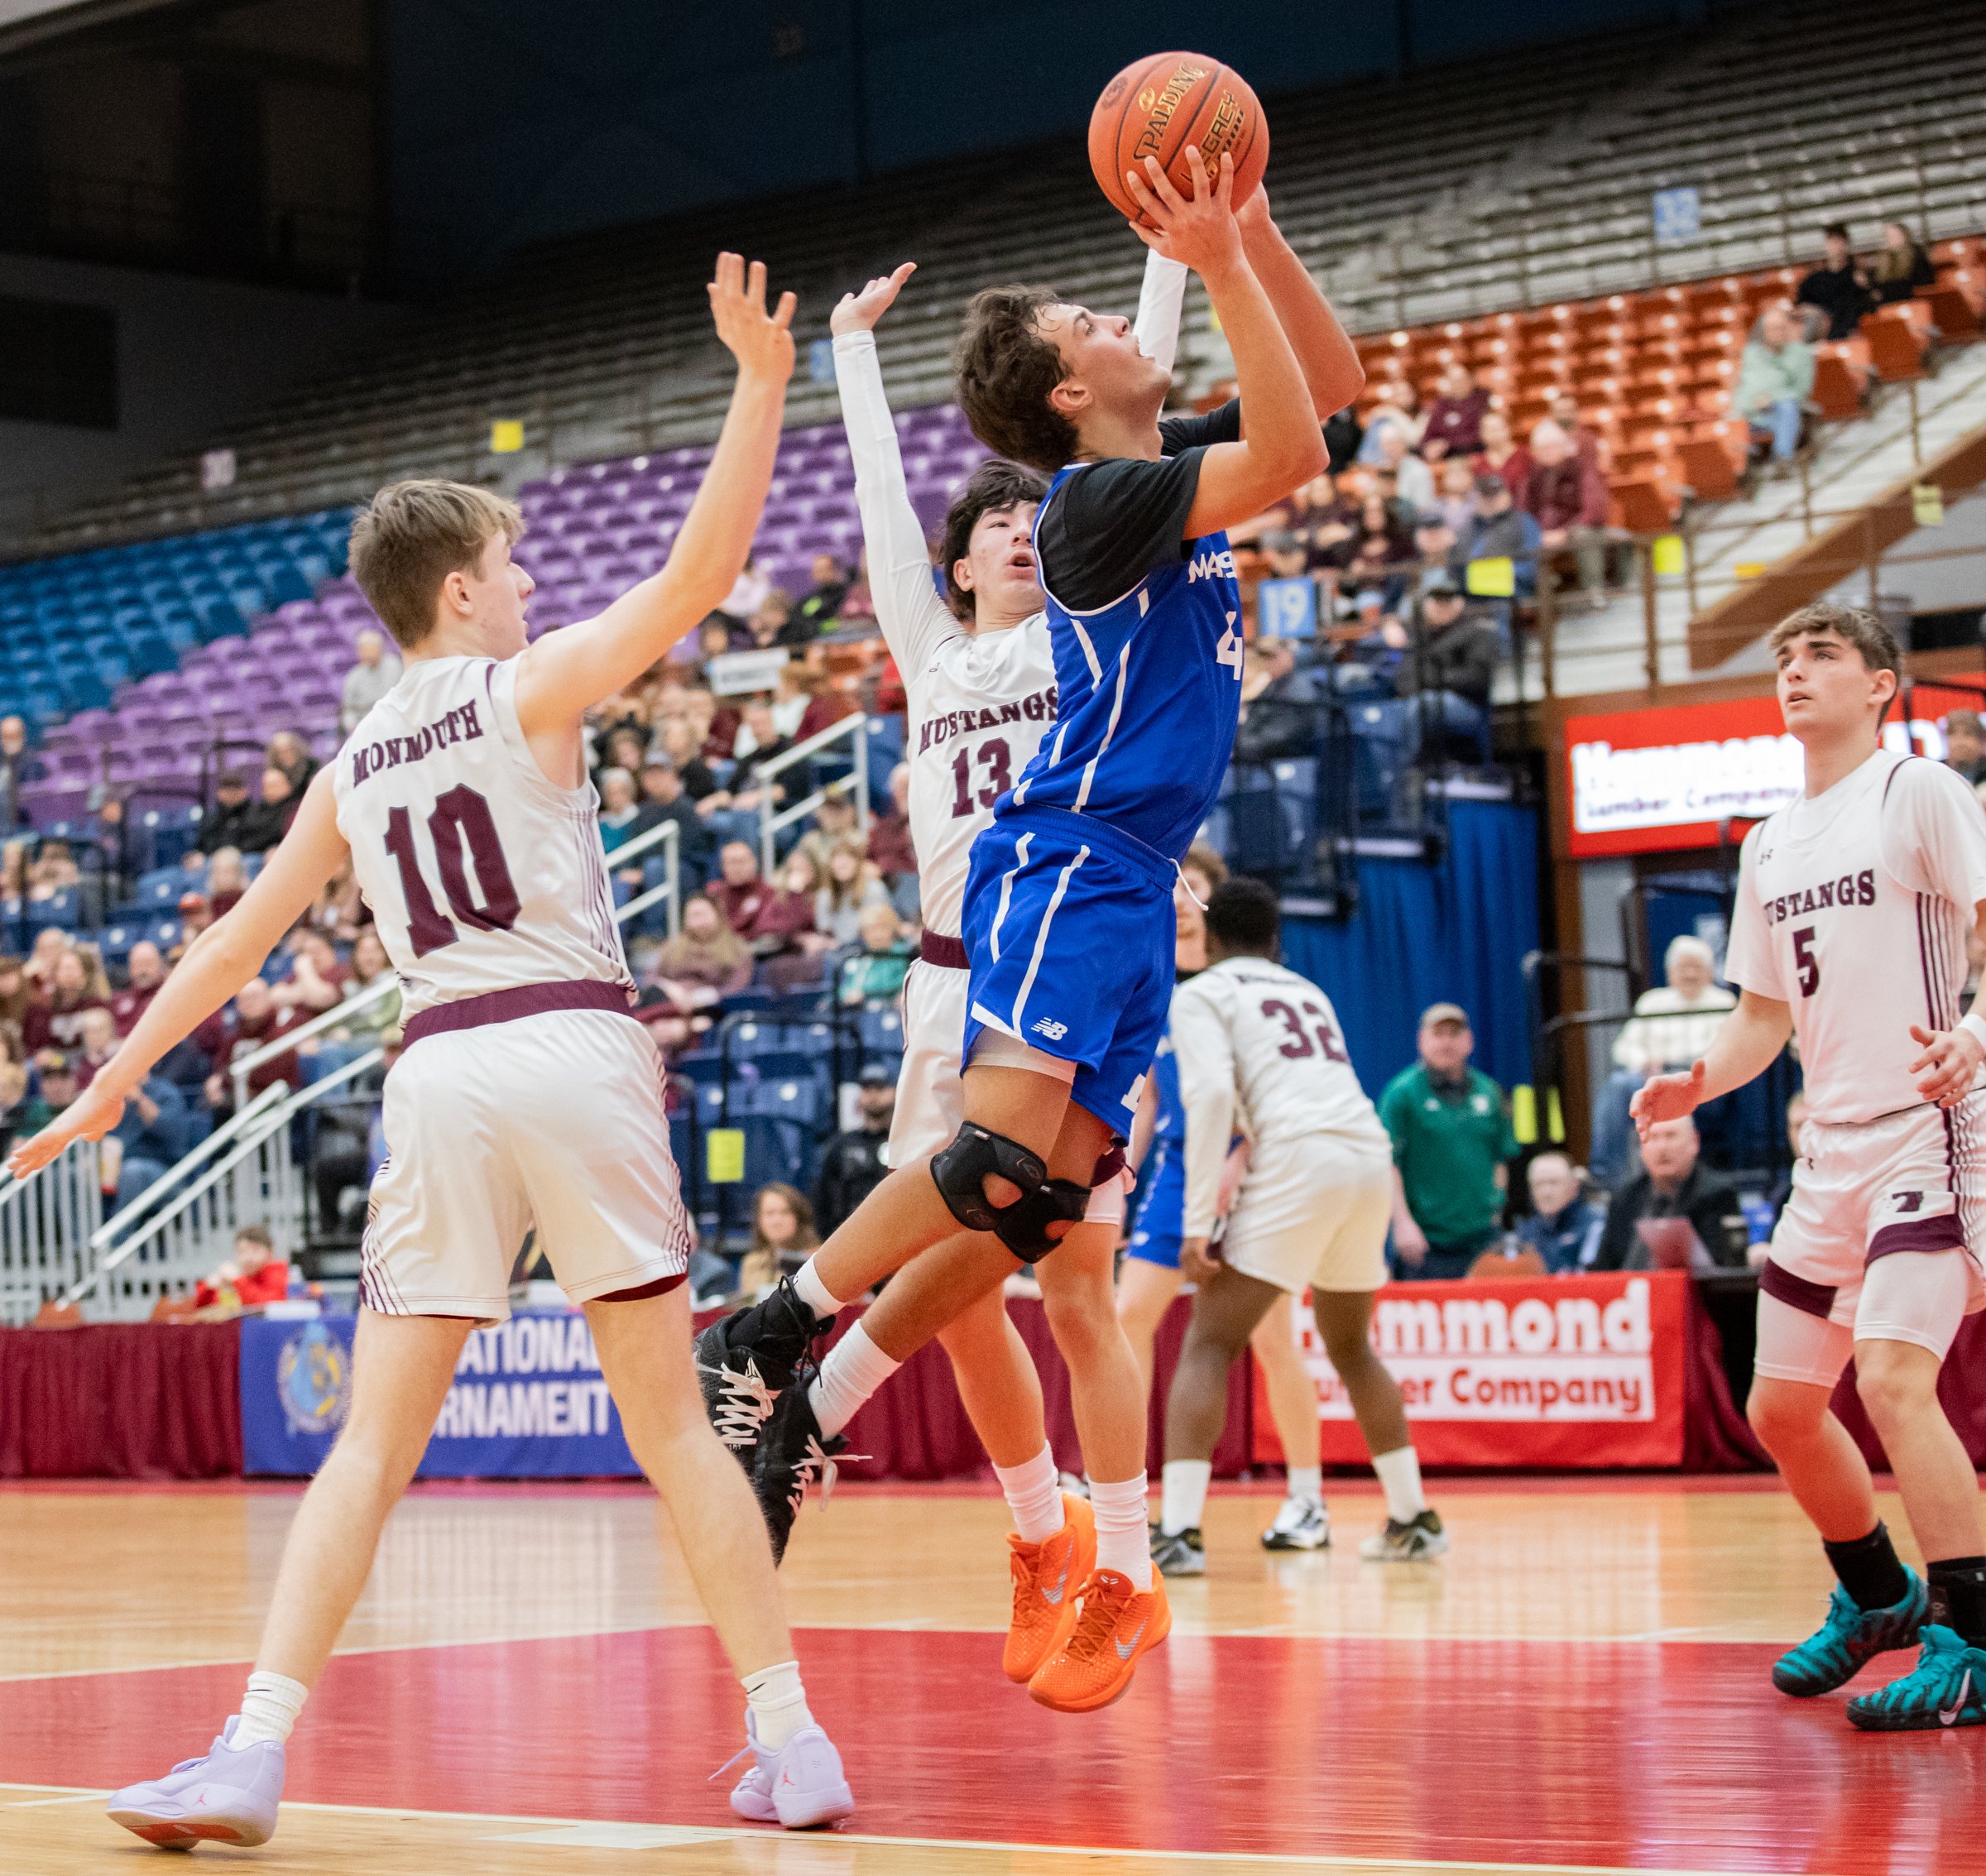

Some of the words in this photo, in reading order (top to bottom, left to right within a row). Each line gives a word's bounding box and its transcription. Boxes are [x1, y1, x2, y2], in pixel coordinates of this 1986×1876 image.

[1133, 62, 1208, 161] SPALDING
[1264, 583, 1309, 636] 19
[353, 698, 483, 789] MONMOUTH
[919, 685, 1059, 757] MUSTANGS
[951, 737, 1012, 819] 13
[383, 783, 522, 959] 10
[1792, 925, 1820, 999] 5
[1261, 1000, 1350, 1063] 32
[1292, 1279, 1652, 1354] Hmmond
[434, 1380, 610, 1438] RNAMENT
[1450, 1368, 1642, 1413] Company
